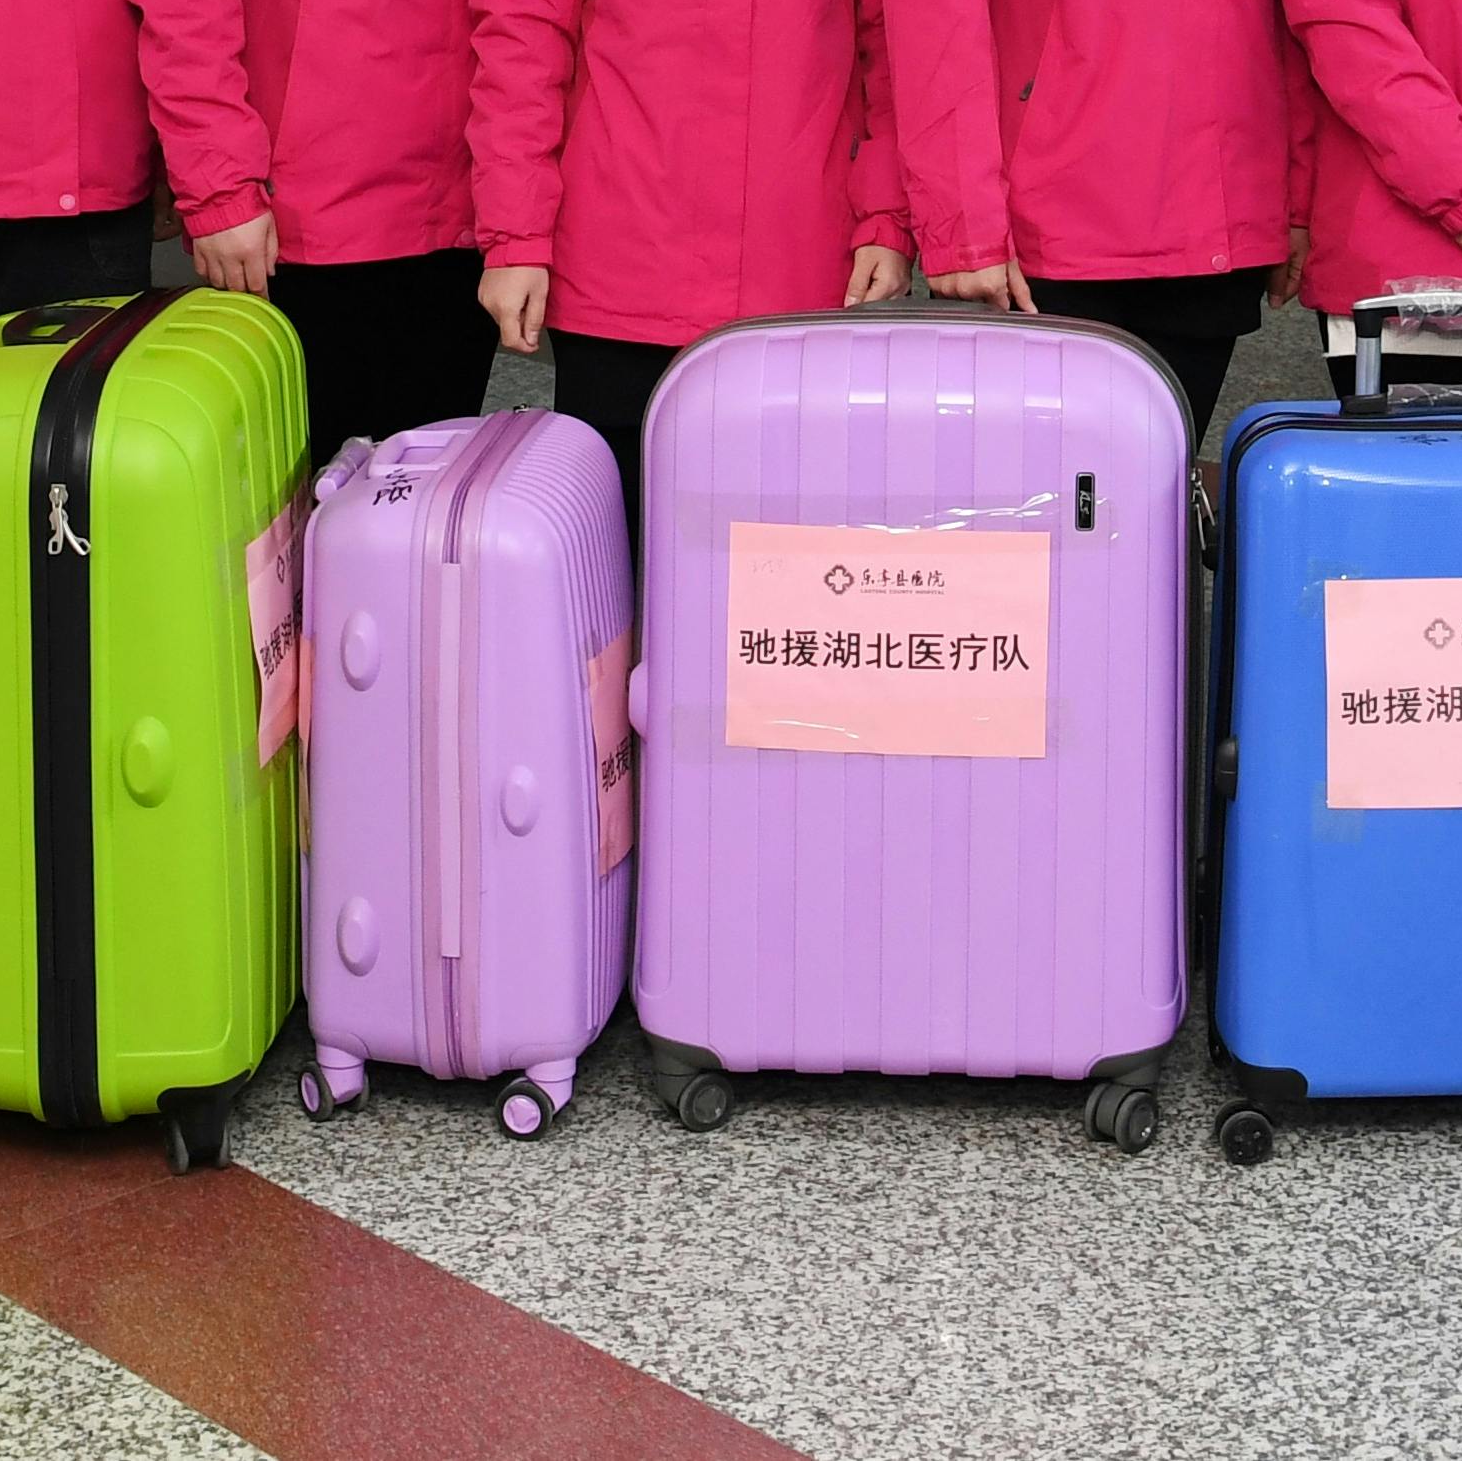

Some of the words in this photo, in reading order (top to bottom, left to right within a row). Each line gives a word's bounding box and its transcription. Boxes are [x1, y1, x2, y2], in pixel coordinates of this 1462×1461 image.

[739, 628, 1031, 672] 驰援湖北医疗队
